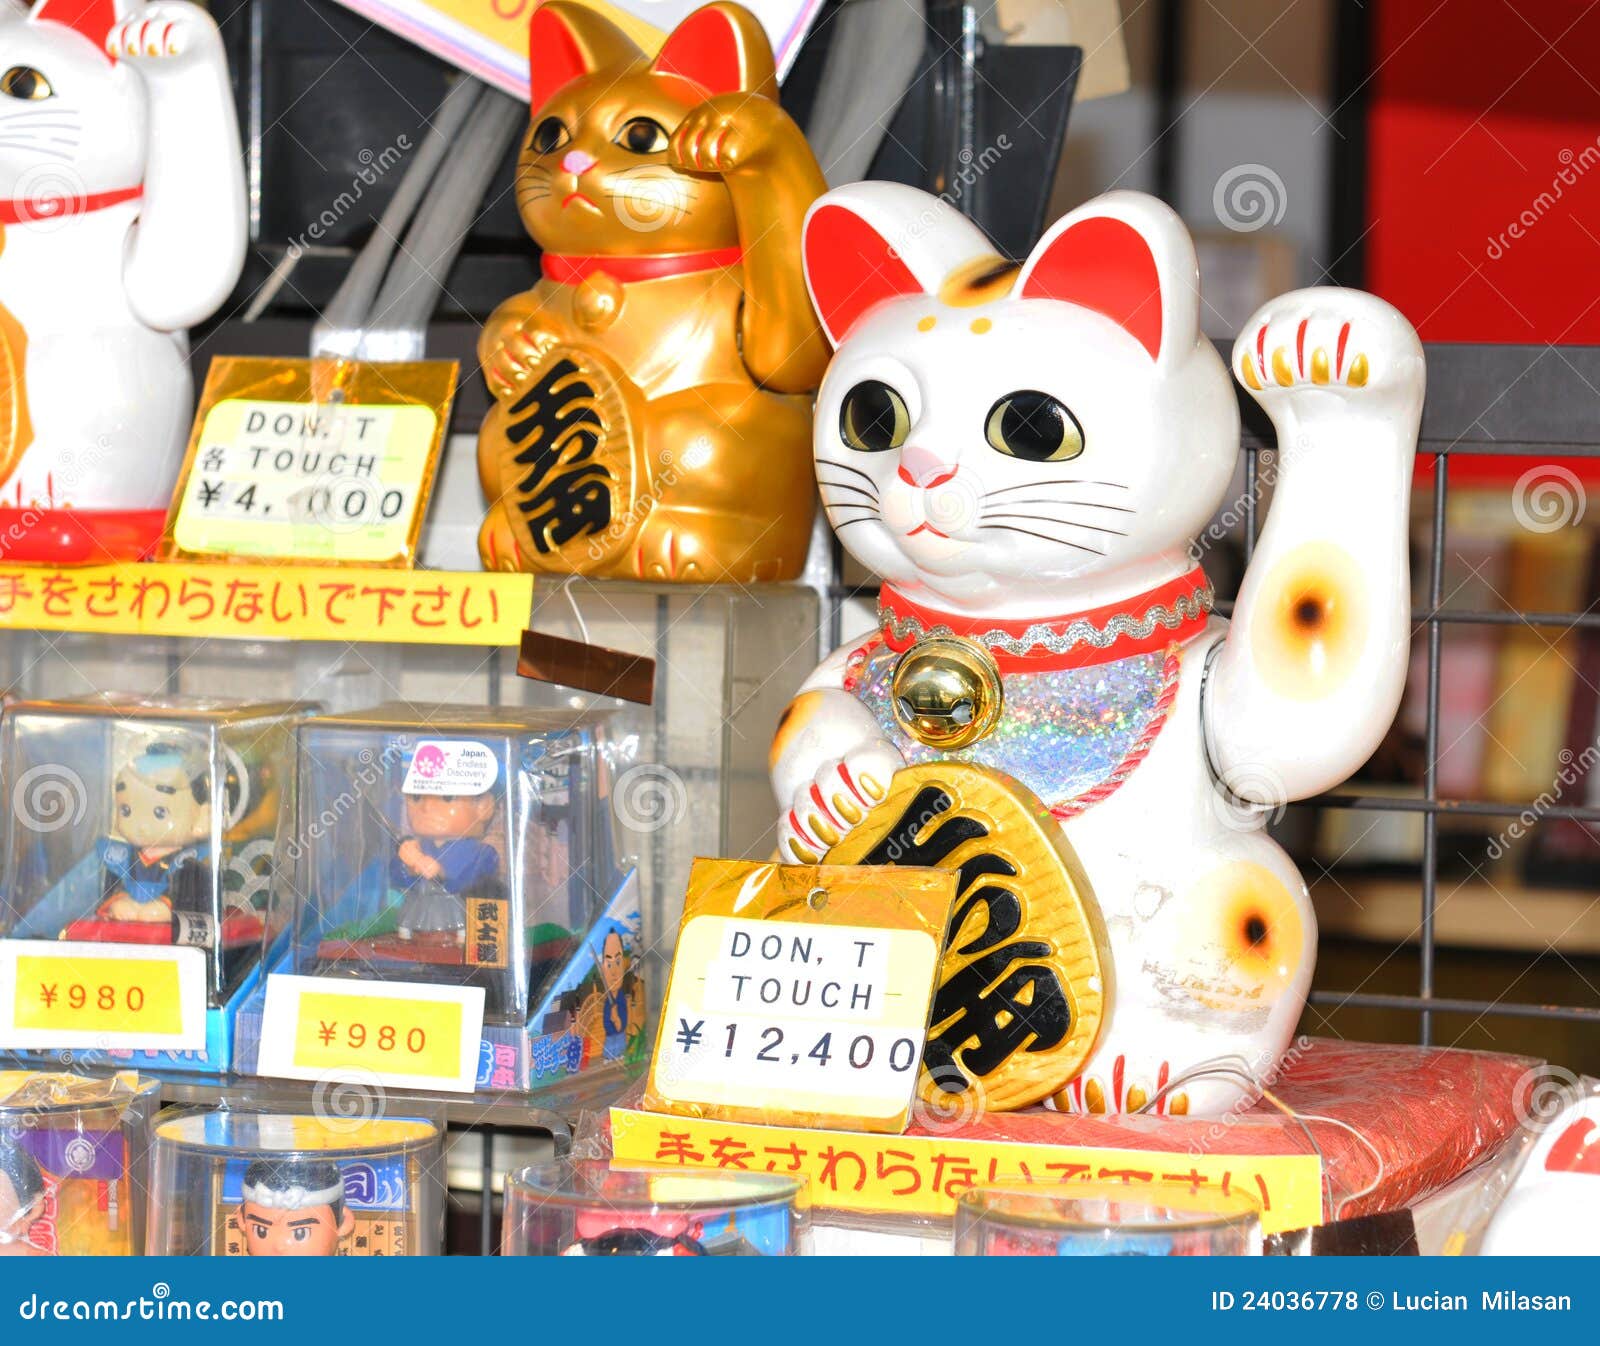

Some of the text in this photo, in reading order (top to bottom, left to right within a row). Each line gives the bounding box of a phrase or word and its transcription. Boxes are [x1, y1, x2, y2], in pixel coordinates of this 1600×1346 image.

[203, 447, 226, 472] 各
[251, 446, 376, 477] TOUCH
[0, 573, 500, 628] 手をさわらないで下さい
[40, 982, 145, 1012] ¥980
[731, 975, 873, 1010] TOUCH
[318, 1020, 426, 1054] ¥980
[676, 1018, 916, 1073] ¥12,400
